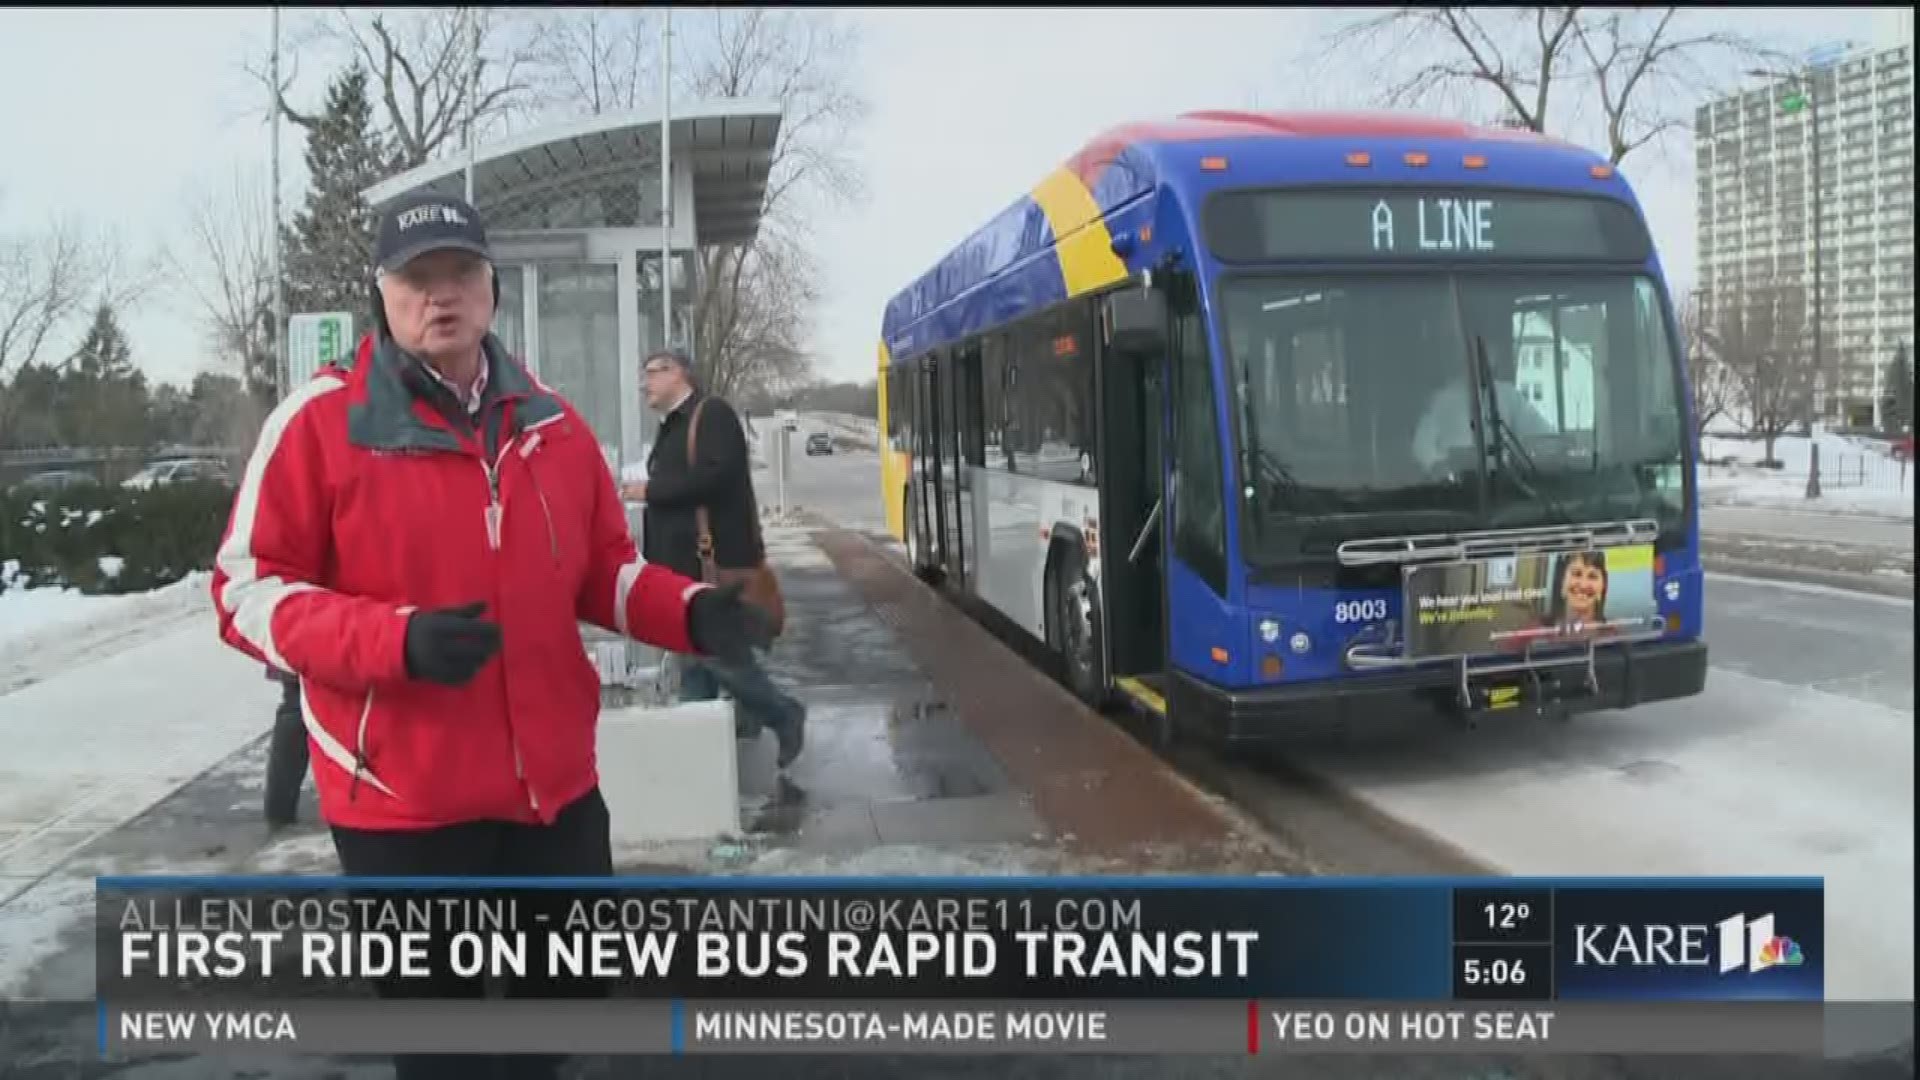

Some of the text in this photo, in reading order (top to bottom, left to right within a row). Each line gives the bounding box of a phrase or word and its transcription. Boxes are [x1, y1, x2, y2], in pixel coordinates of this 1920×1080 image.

[1373, 199, 1494, 250] A LINE
[1335, 600, 1386, 623] 8003
[1419, 596, 1435, 609] We
